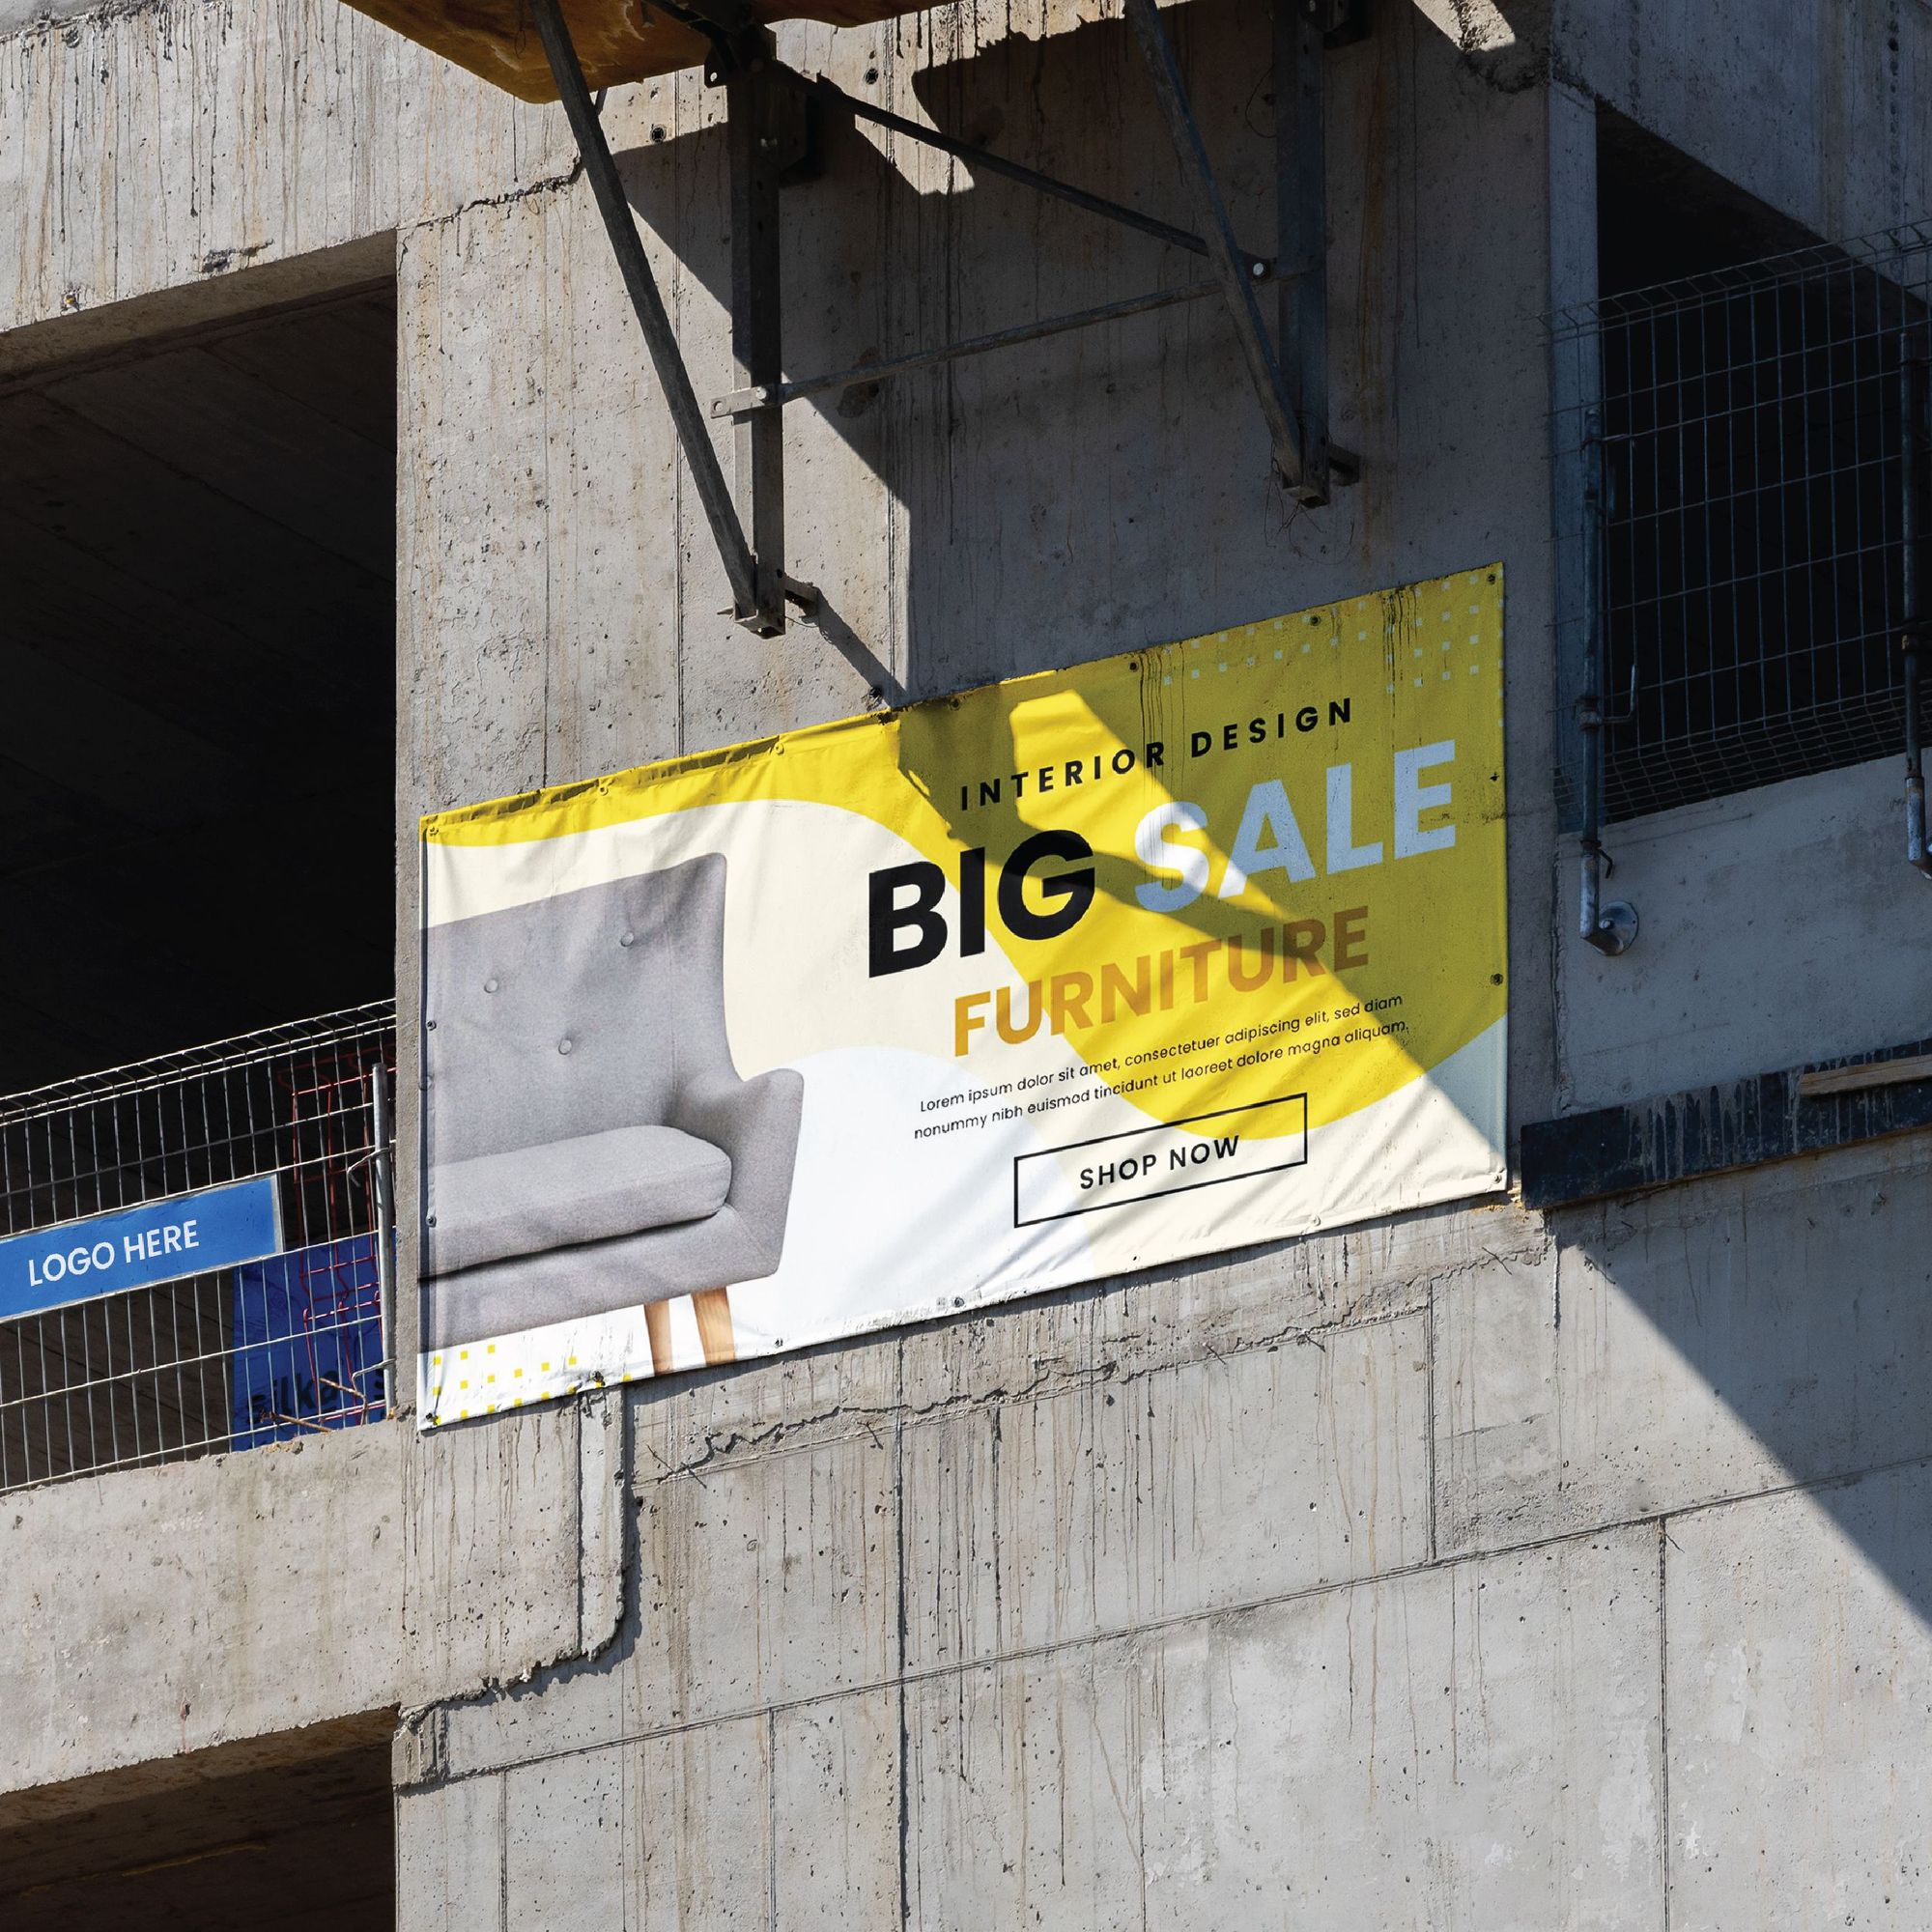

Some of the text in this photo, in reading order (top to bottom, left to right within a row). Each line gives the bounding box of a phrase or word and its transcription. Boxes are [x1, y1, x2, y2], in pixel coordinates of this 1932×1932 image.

[961, 697, 1351, 811] INTERIOR DESIGN
[868, 739, 1456, 979] BIG SALE
[954, 905, 1369, 1057] FURNITURE
[914, 1019, 1409, 1139] nonummy nibh euismod tincidunt ut laoreet dolore magna aliquam.
[921, 995, 1403, 1112] Lorem ipsum dolor sit amet, consectetuer adipiscing elit, sed diam
[1079, 1135, 1239, 1190] SHOP NOW
[28, 1219, 201, 1287] LOGO HERE
